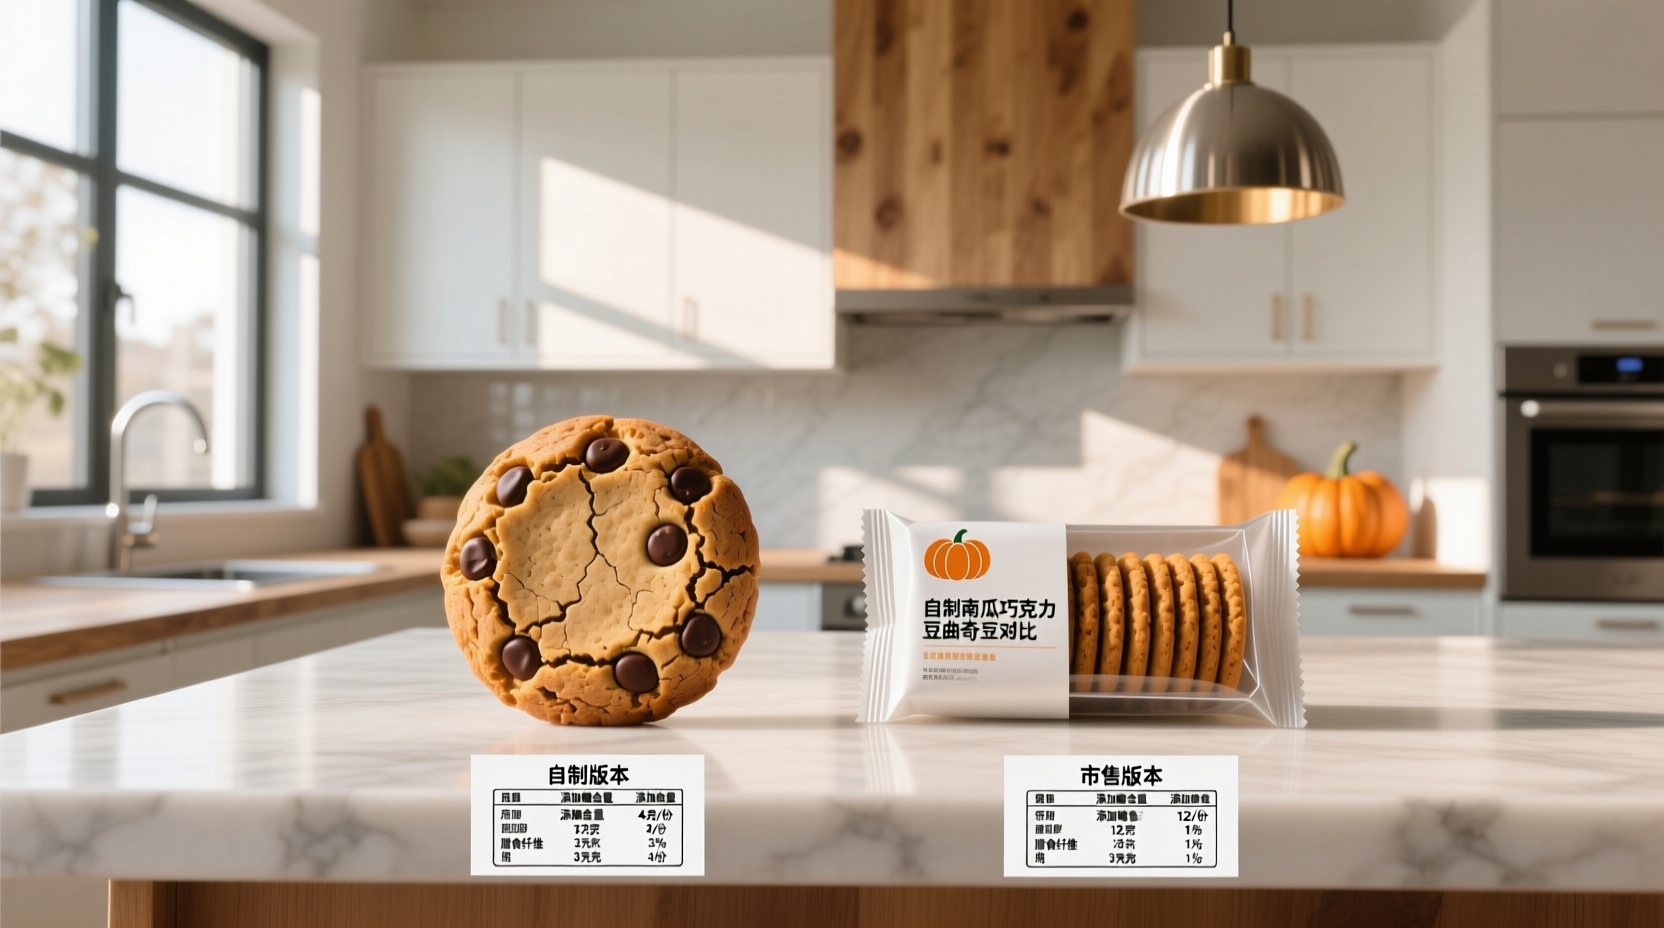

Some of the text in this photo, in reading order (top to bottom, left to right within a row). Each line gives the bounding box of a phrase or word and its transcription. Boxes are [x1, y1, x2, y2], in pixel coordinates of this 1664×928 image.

[924, 598, 1056, 619] 自制南瓜巧克力
